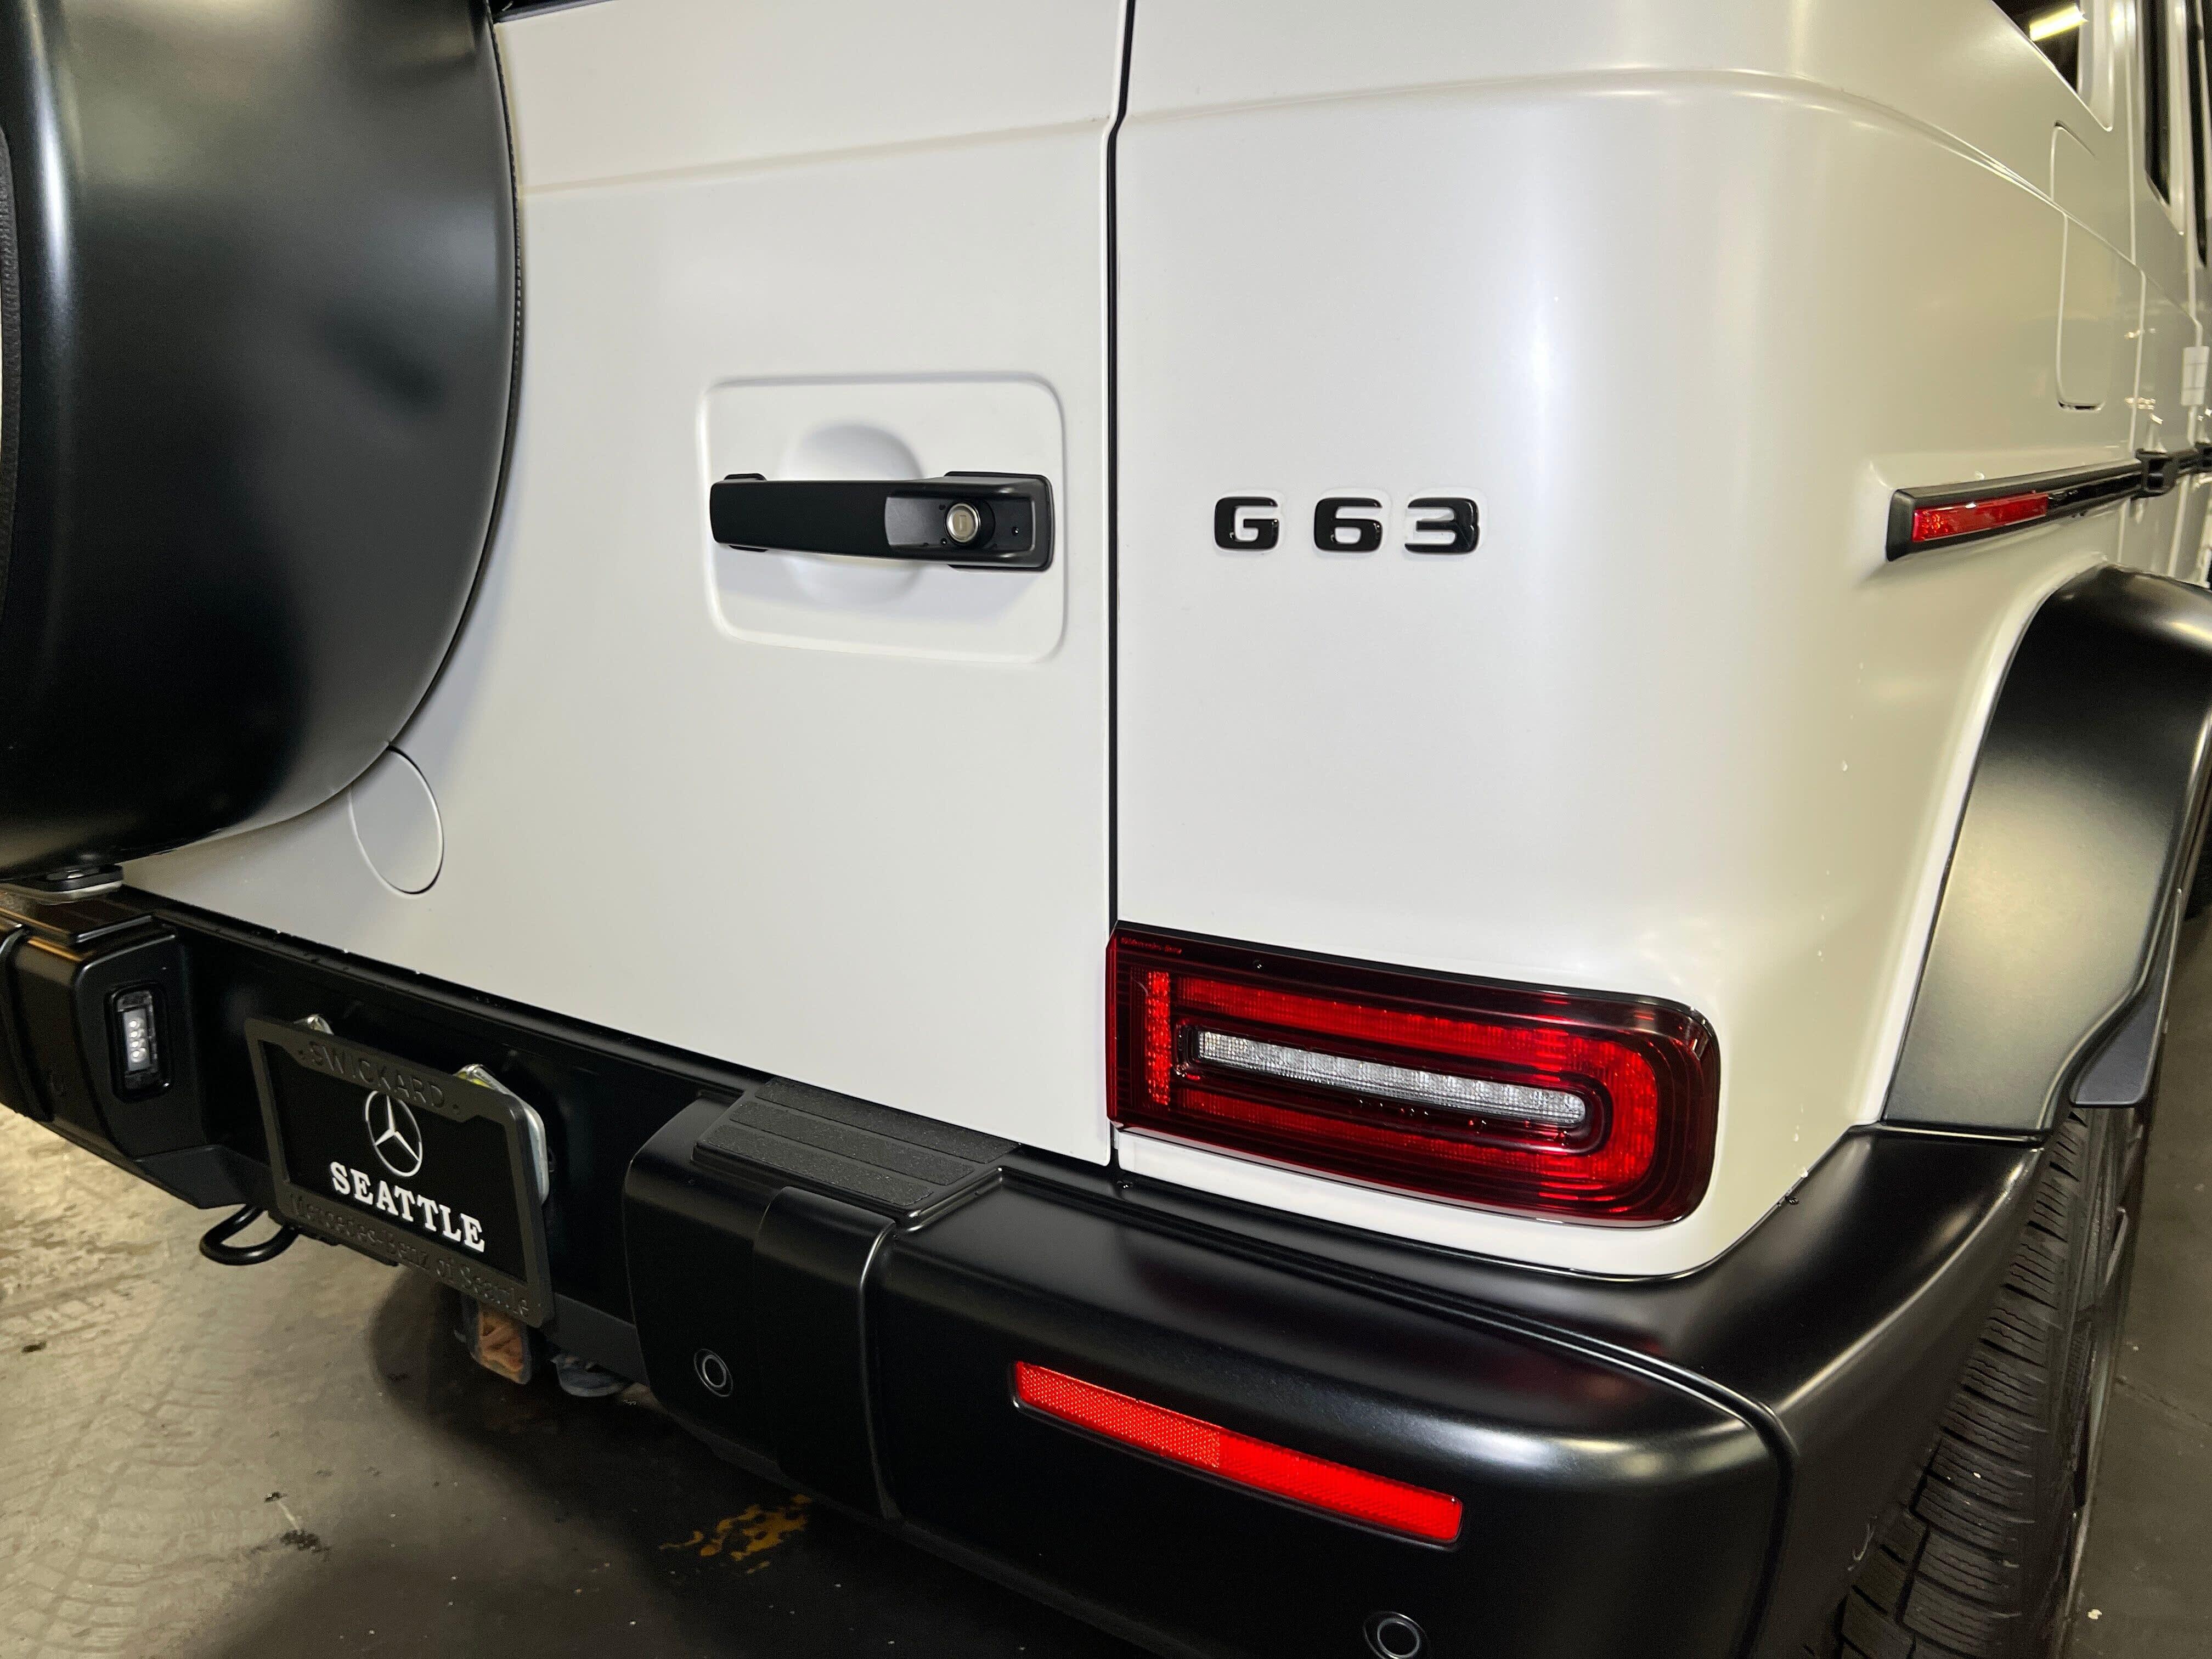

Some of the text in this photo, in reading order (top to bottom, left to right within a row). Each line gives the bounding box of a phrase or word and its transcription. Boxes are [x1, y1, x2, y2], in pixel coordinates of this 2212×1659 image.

[1214, 496, 1480, 555] G 63
[309, 1040, 444, 1108] SWICKARD
[330, 1161, 485, 1252] SEATTLE
